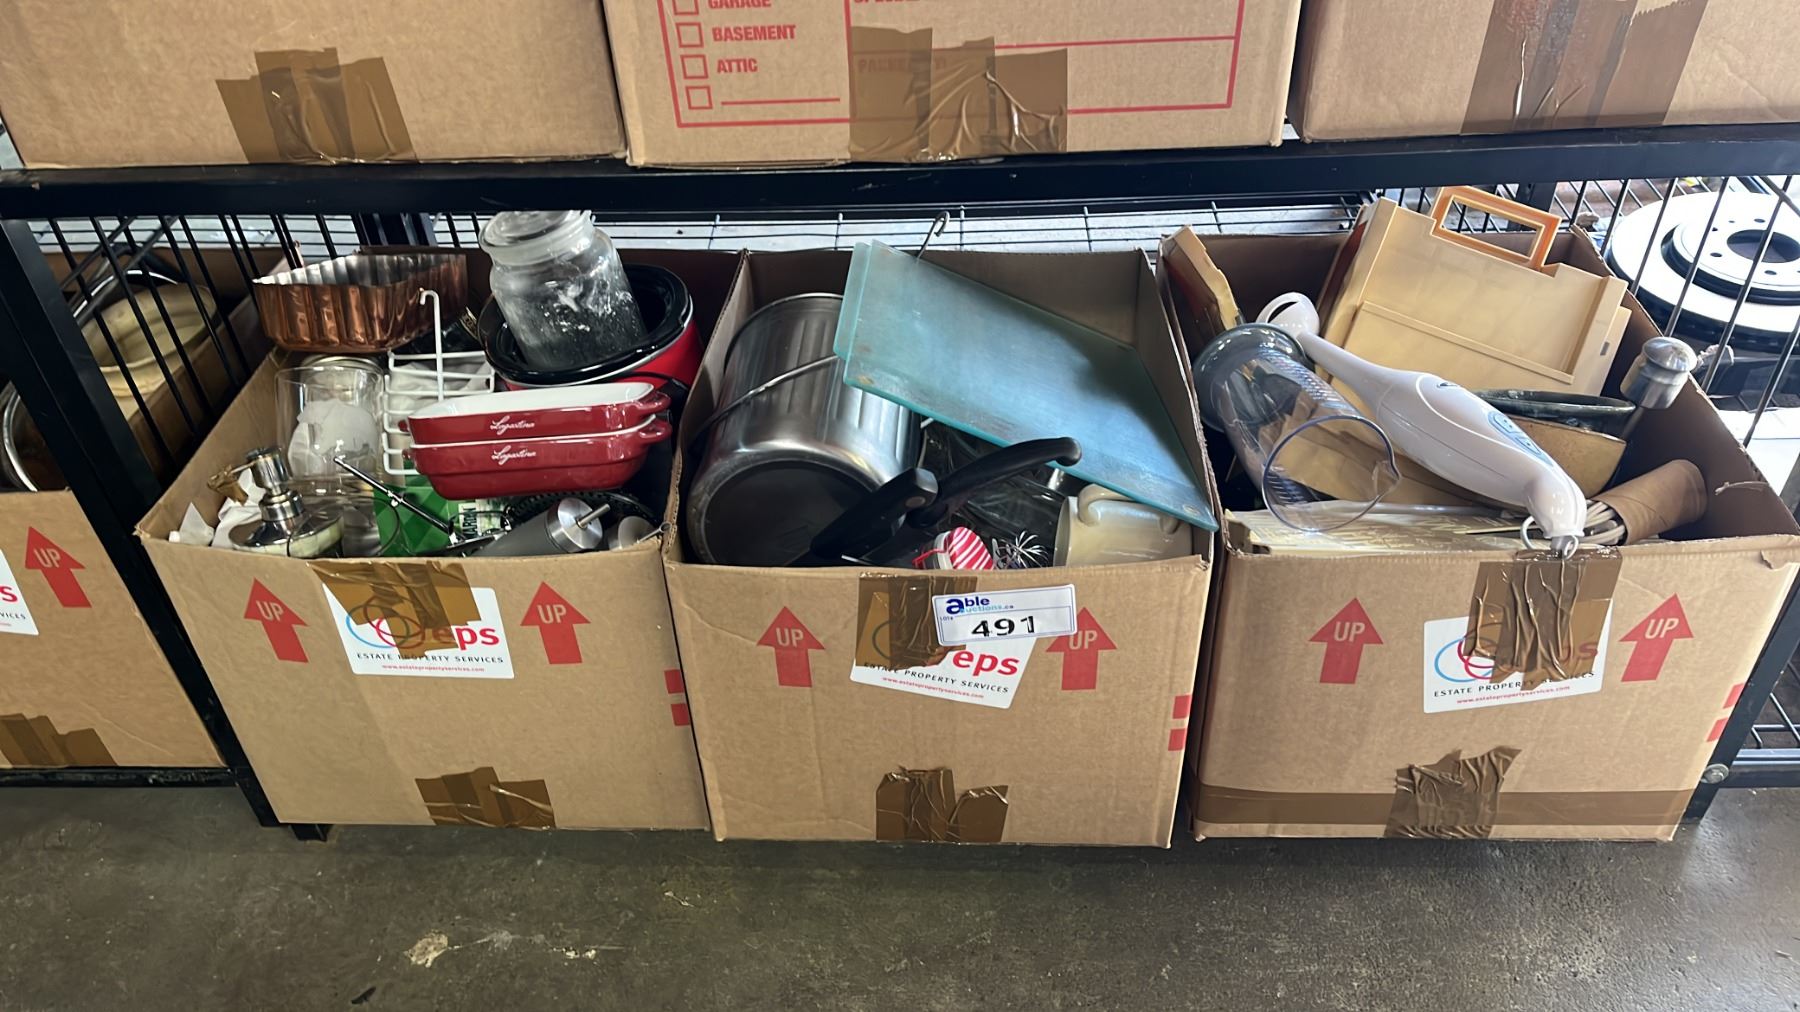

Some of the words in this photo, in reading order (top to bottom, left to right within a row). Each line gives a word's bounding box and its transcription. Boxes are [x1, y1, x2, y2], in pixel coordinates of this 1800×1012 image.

[712, 24, 797, 42] BASEMENT
[716, 58, 758, 73] ATTIC
[33, 548, 61, 568] UP
[256, 600, 284, 621] UP
[537, 604, 567, 624] UP
[971, 615, 1035, 637] 491
[1333, 621, 1365, 642] UP
[1644, 617, 1679, 638] UP
[776, 627, 804, 647] UP
[1069, 630, 1098, 650] UP
[356, 653, 394, 661] ESTATE
[455, 655, 504, 664] SERVICES
[953, 650, 1020, 677] eps
[904, 669, 957, 685] PROPERTY
[961, 680, 1009, 694] SERVICES
[1433, 688, 1473, 698] ESTATE
